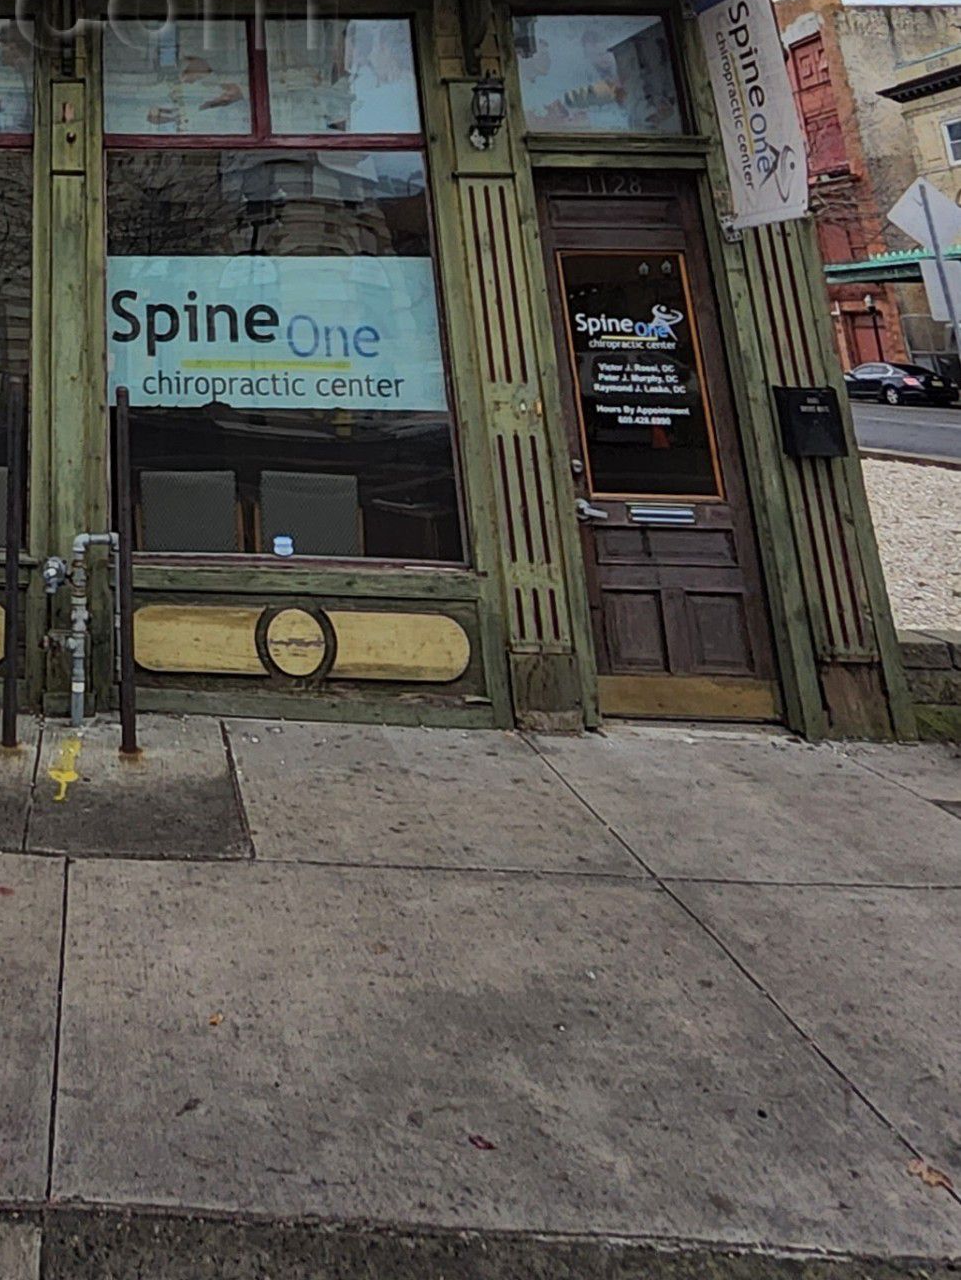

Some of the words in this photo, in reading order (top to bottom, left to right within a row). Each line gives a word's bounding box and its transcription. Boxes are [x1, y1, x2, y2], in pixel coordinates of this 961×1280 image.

[728, 0, 765, 108] Spine
[715, 31, 744, 128] chiropractic
[738, 132, 754, 190] center
[111, 290, 280, 356] Spine
[287, 315, 380, 358] One
[575, 313, 634, 335] Spine
[589, 339, 644, 350] chiropractic
[646, 341, 677, 350] center
[661, 365, 676, 373] DC
[143, 370, 306, 402] chiropractic
[316, 374, 405, 398] center
[665, 375, 679, 383] DC
[593, 383, 634, 393] Raymond
[673, 385, 687, 394] DC
[596, 404, 622, 414] Hours
[623, 405, 636, 415] By
[636, 405, 691, 416] Appointment
